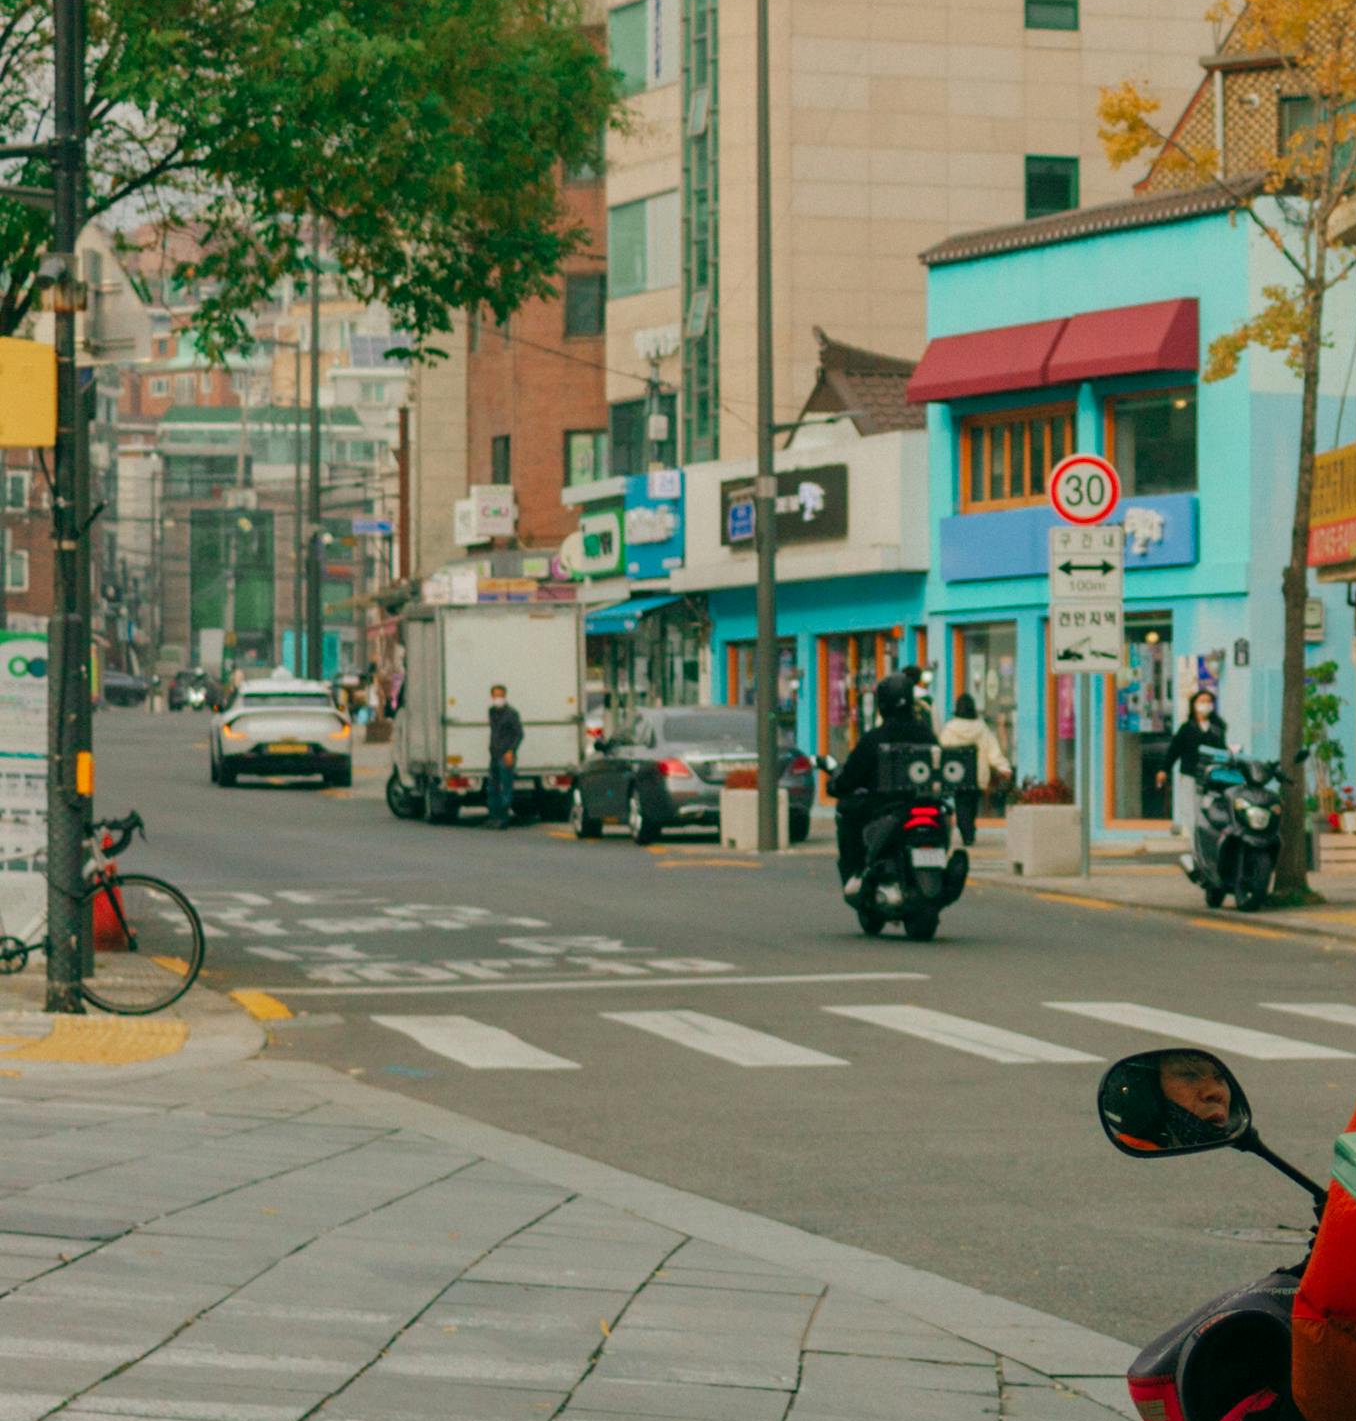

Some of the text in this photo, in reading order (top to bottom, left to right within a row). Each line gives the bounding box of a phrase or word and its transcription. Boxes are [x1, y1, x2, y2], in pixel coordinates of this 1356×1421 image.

[1064, 474, 1105, 507] 30
[1069, 579, 1107, 593] 100m
[1058, 610, 1117, 627] 견인지역
